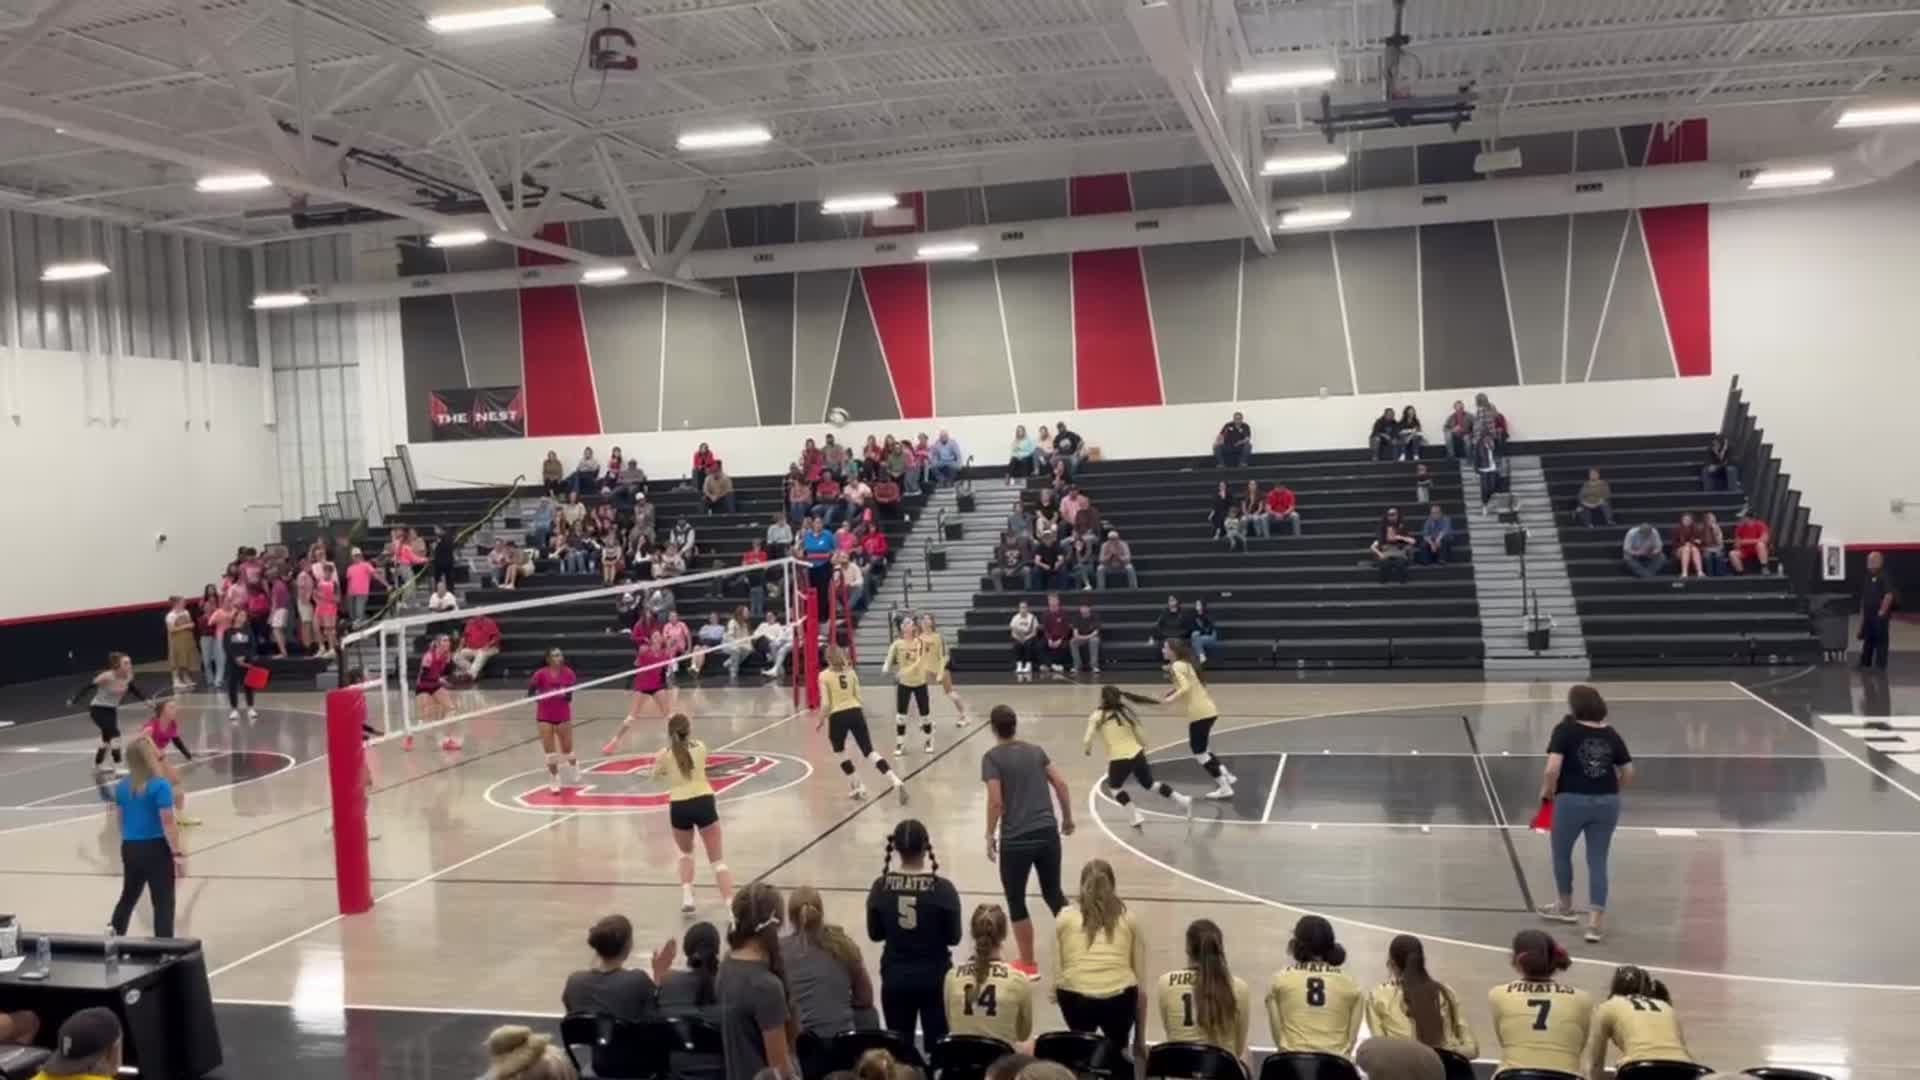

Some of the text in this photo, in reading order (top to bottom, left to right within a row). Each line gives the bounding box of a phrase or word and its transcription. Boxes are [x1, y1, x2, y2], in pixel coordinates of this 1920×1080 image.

[437, 410, 518, 424] THE NEST
[898, 895, 917, 929] 5
[956, 963, 1009, 978] PIRTES
[963, 983, 996, 1016] 14
[1306, 977, 1326, 1007] 8
[1506, 981, 1576, 995] PIRATES
[1182, 992, 1194, 1027] 1
[1527, 999, 1551, 1031] 7
